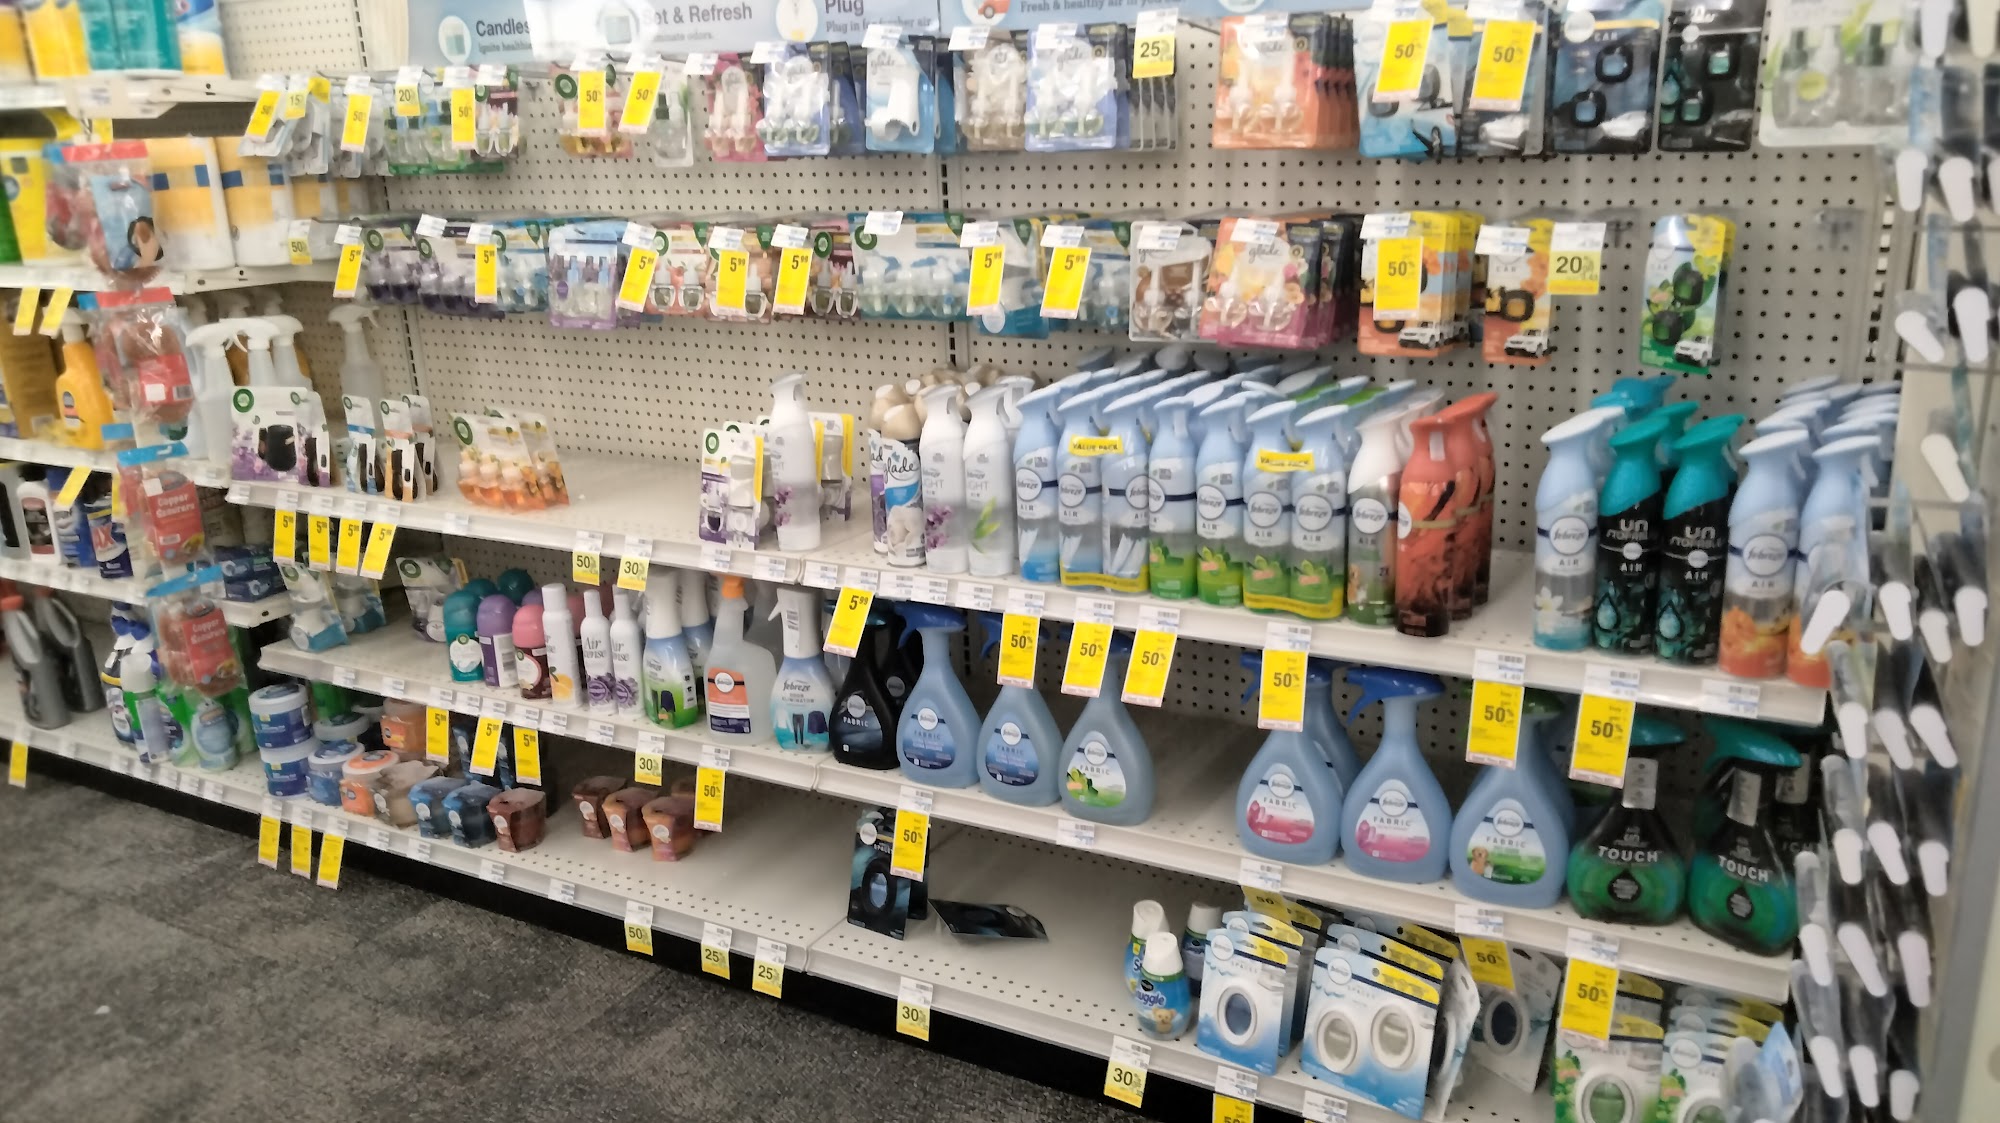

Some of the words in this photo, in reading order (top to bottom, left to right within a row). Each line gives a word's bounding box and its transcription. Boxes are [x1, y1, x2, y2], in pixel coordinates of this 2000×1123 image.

[673, 5, 685, 23] &
[689, 2, 753, 23] Refresh
[826, 20, 848, 33] Plug
[884, 456, 914, 477] glade
[158, 492, 189, 506] Copper
[1063, 510, 1078, 518] AIR
[1202, 522, 1217, 530] AIR
[1303, 534, 1321, 542] AIR
[1553, 529, 1586, 541] febreze
[1559, 559, 1579, 567] AIR
[1619, 562, 1643, 572] AIR
[1684, 570, 1709, 580] AIR
[1752, 580, 1775, 588] AIR
[585, 635, 602, 650] Air
[783, 678, 811, 692] febreze
[843, 715, 869, 728] FABRIC
[914, 731, 942, 742] FABRIC
[1079, 765, 1111, 777] FABRIC
[1263, 796, 1298, 809] FABRIC
[1373, 815, 1411, 828] FABRIC
[1486, 836, 1527, 849] FABRIC
[1597, 846, 1659, 863] TOUCH
[1718, 854, 1769, 883] TOUCH
